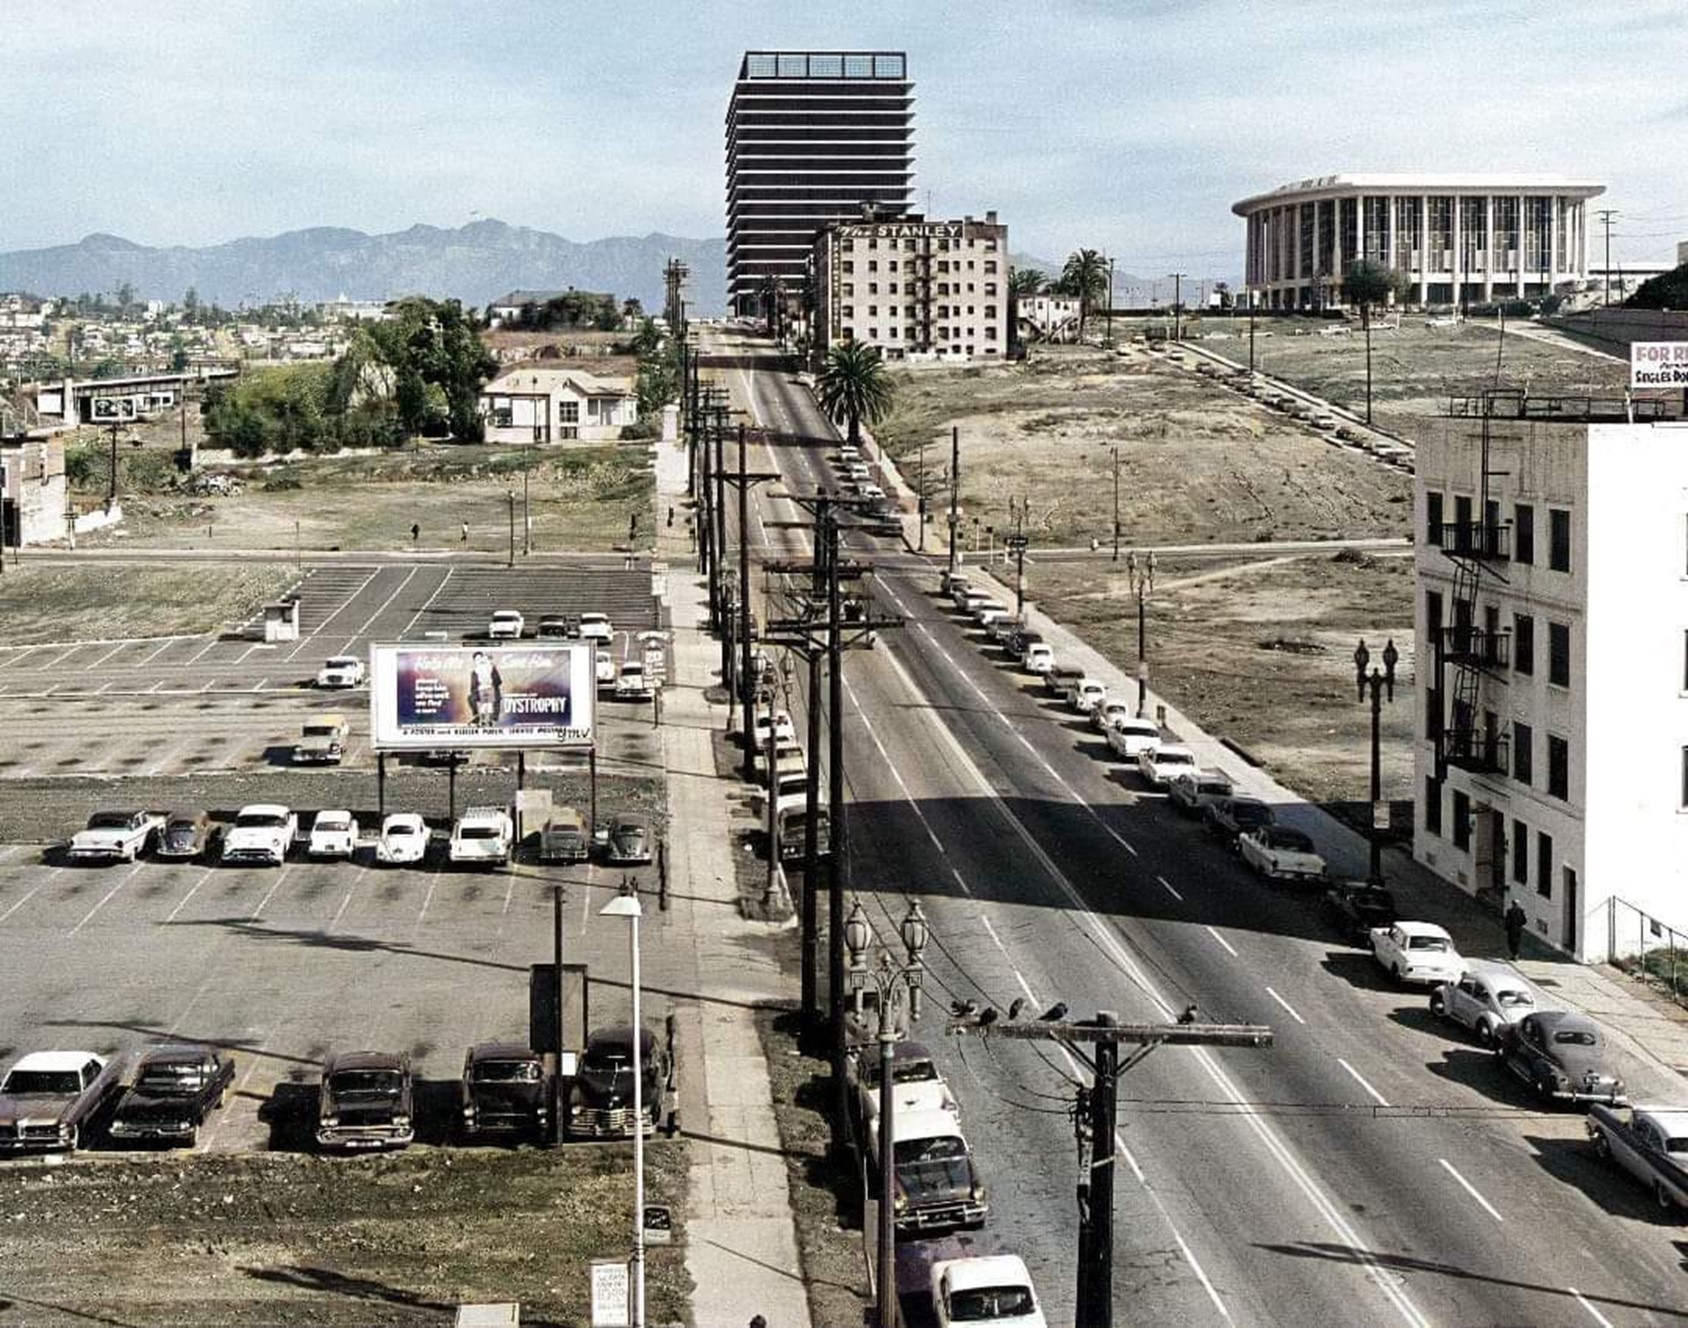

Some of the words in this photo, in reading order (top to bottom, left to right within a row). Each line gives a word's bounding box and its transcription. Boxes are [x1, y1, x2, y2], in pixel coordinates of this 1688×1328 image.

[878, 225, 958, 237] STANLEY
[1636, 346, 1670, 362] FOR
[503, 697, 567, 714] DYSTROPHY
